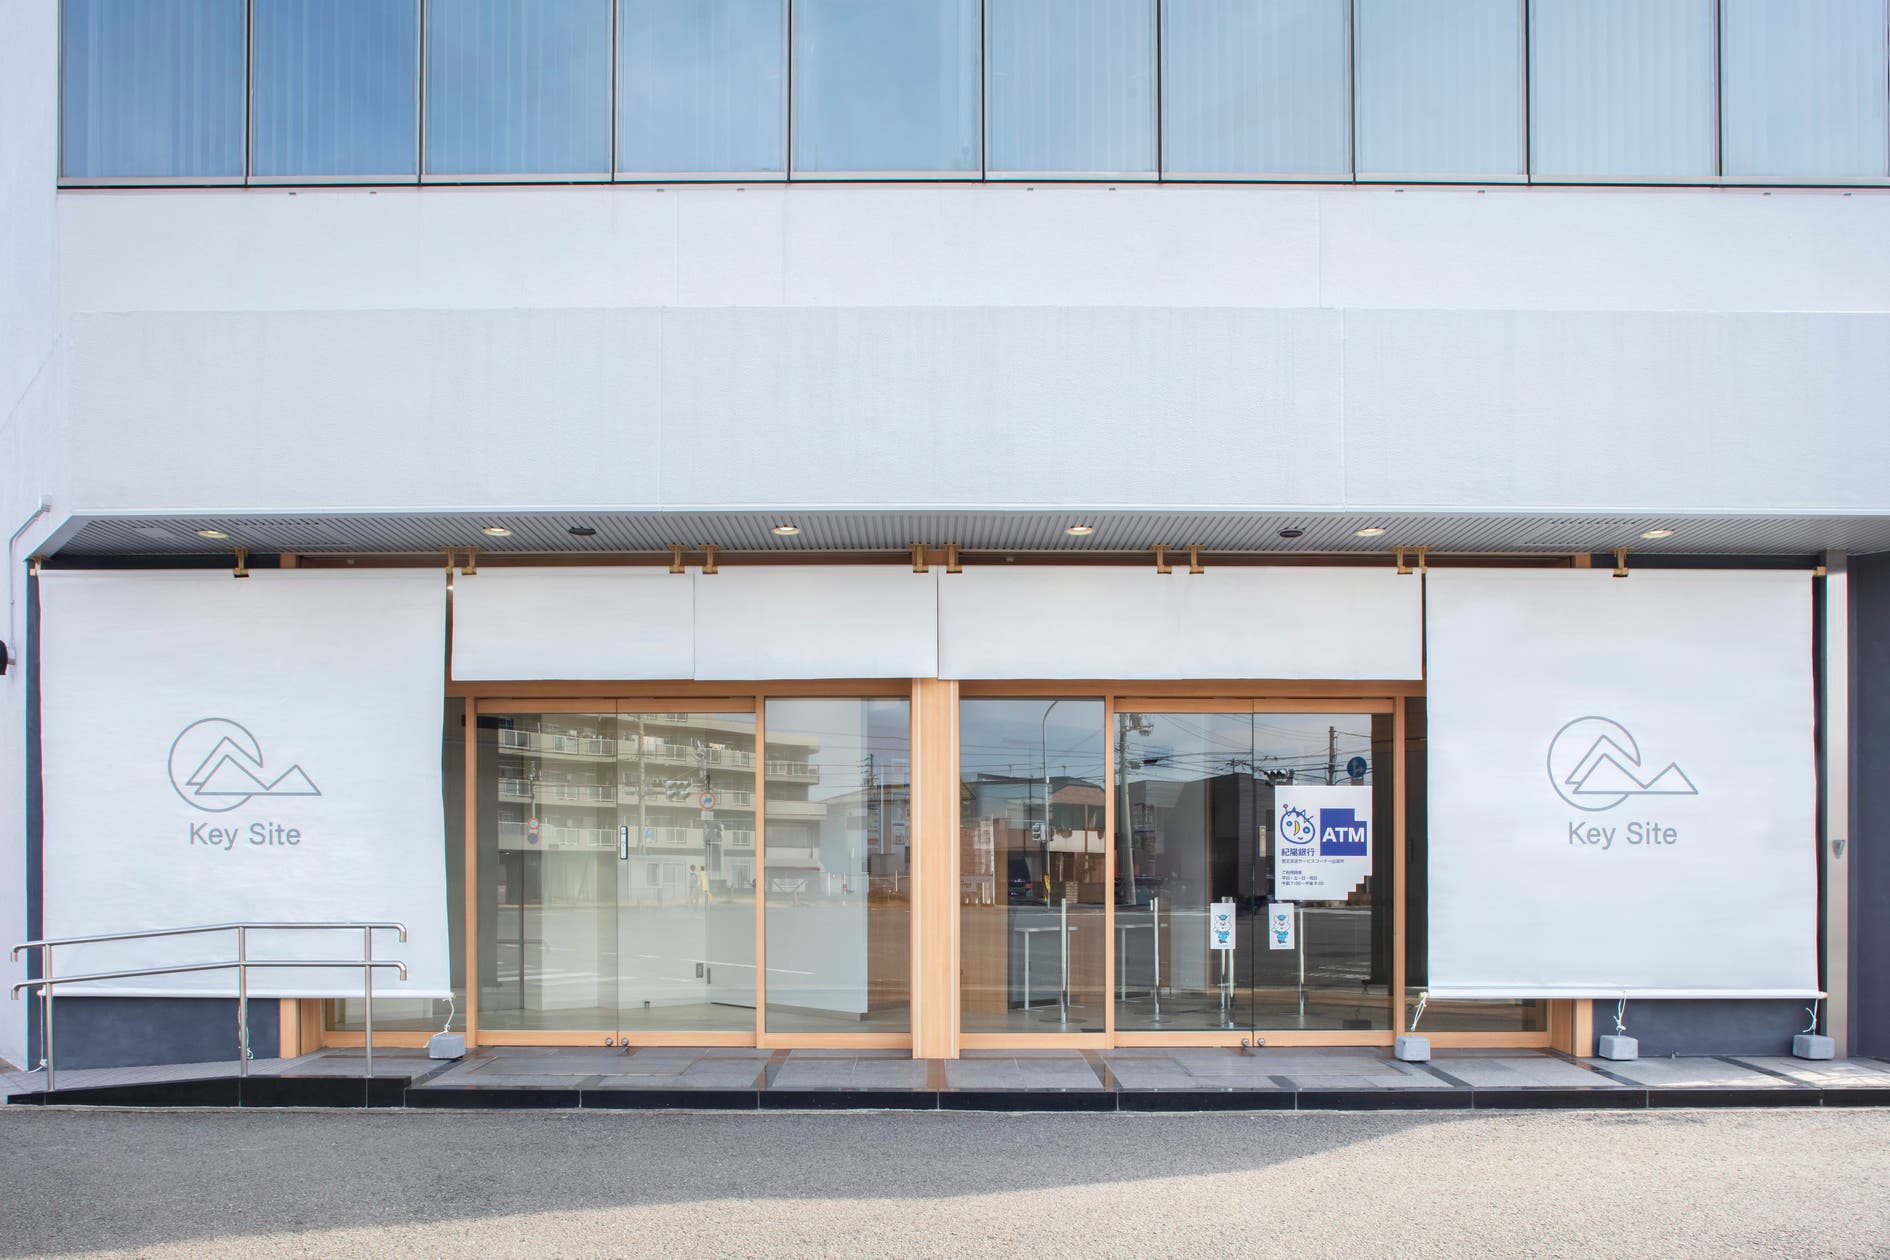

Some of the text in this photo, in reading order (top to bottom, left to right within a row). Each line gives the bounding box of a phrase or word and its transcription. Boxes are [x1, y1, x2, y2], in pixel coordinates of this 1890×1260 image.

[190, 821, 301, 851] Key Site
[1322, 827, 1365, 843] ATM
[1568, 821, 1677, 850] Key Site
[1281, 847, 1315, 857] 紀陽銀行
